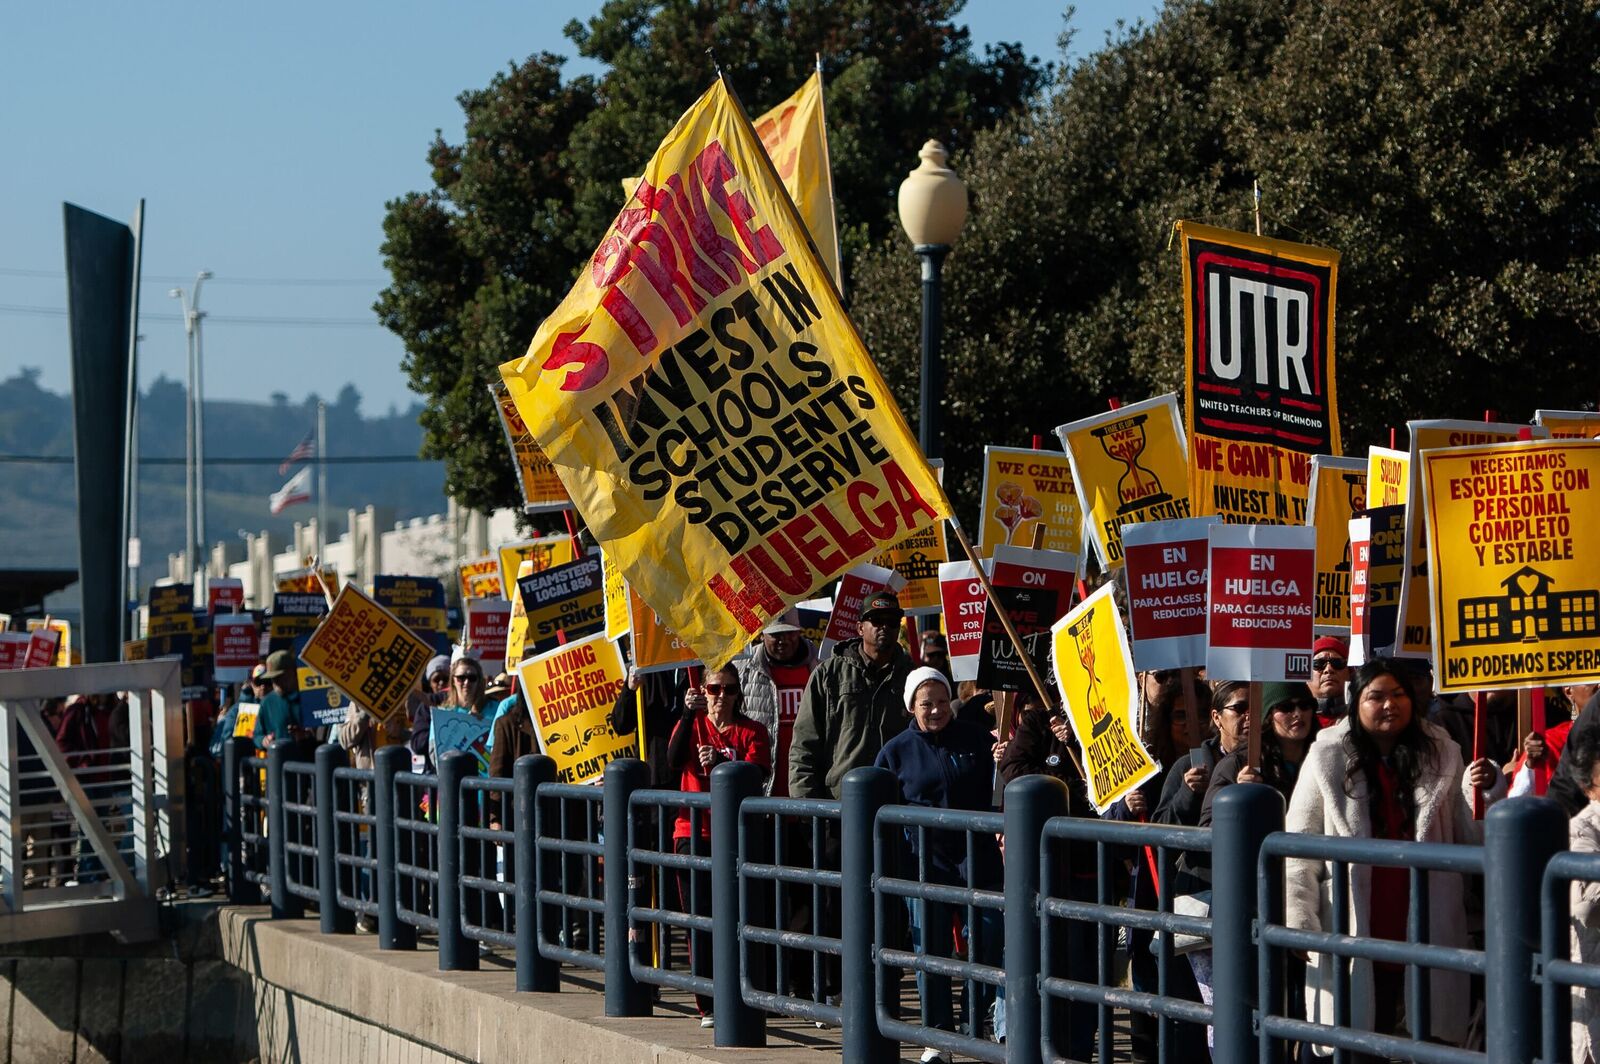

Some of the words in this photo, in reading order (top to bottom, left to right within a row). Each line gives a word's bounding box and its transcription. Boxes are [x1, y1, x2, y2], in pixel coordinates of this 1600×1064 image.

[1209, 272, 1312, 395] UTR
[592, 291, 778, 462] INVEST
[761, 263, 822, 334] IN
[629, 342, 832, 500] SCHOOLS
[1200, 398, 1229, 413] UNITED
[1230, 403, 1271, 417] TEACHERS
[1273, 410, 1281, 419] OF
[1282, 412, 1322, 429] RICHMOND
[1109, 438, 1142, 455] CAN'T
[1111, 429, 1135, 442] WE
[674, 375, 876, 525] STUDENTS
[1195, 437, 1224, 472] WE
[1227, 443, 1284, 480] CAN'T
[997, 461, 1024, 476] WE
[1381, 459, 1401, 487] SUELDO
[1471, 453, 1566, 475] NECESITAMOS
[705, 419, 889, 555] DESERVE
[1121, 480, 1158, 502] WAIT
[1450, 472, 1544, 499] ESCUELAS
[1552, 468, 1590, 491] CON
[1055, 501, 1075, 514] for
[1213, 485, 1271, 515] INVEST
[1274, 490, 1291, 519] IN
[1473, 493, 1570, 521] PERSONAL
[1052, 514, 1073, 525] the
[1469, 516, 1570, 544] COMPLETO
[707, 461, 937, 635] HUELGA
[905, 537, 938, 550] DESERVE
[1048, 541, 1072, 550] our
[1163, 547, 1187, 564] EN
[1475, 546, 1486, 566] Y
[1494, 539, 1573, 565] ESTABLE
[1250, 554, 1275, 571] EN
[522, 560, 599, 593] TEAMSTERS
[536, 583, 570, 602] LOCAL
[571, 576, 592, 592] 856
[860, 583, 874, 595] EN
[1022, 571, 1046, 586] ON
[1225, 579, 1300, 596] HUELGA
[1317, 571, 1350, 595] FULL
[560, 600, 579, 613] ON
[843, 595, 864, 610] HUE
[959, 602, 986, 616] STRI
[1134, 595, 1162, 609] PARA
[1165, 593, 1201, 606] CLASES
[1213, 603, 1243, 615] PARA
[1244, 604, 1285, 615] CLASES
[1287, 602, 1312, 616] MÁS
[323, 610, 355, 652] FULLY
[487, 614, 500, 624] EN
[963, 621, 980, 630] FOR
[1232, 618, 1292, 629] REDUCIDAS
[951, 632, 983, 642] STAFFED
[1405, 625, 1423, 645] NO
[340, 617, 388, 682] SCHOOLS
[545, 645, 597, 679] LIVING
[1288, 656, 1308, 672] UTR
[1449, 657, 1468, 679] NO
[1472, 651, 1544, 678] PODEMOS
[378, 698, 392, 713] WE
[389, 672, 412, 700] CAN'T
[406, 649, 424, 674] WAIT!
[538, 673, 583, 704] WAGE
[586, 668, 607, 687] FOR
[538, 679, 624, 727] EDUCATORS
[576, 749, 609, 778] CAN'T
[1088, 737, 1113, 772] FULLY
[1094, 769, 1112, 800] OUR
[1113, 743, 1147, 787] SCHOOLS
